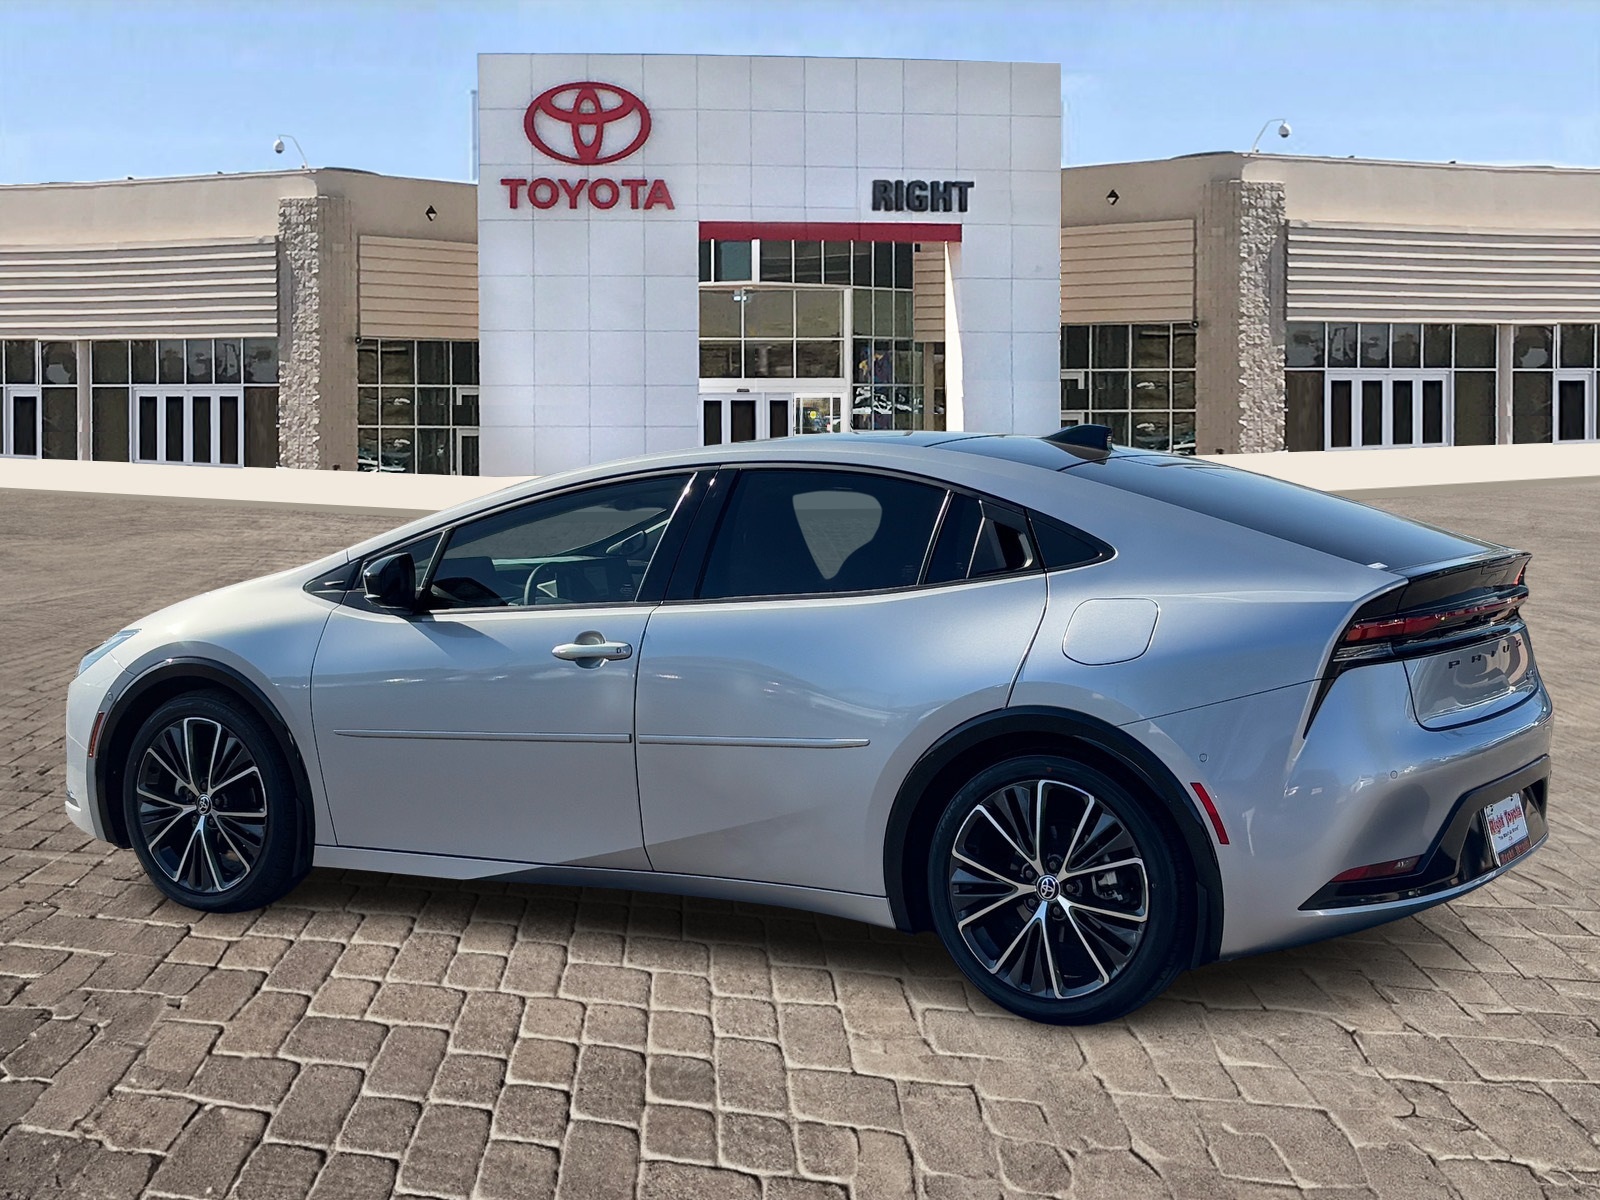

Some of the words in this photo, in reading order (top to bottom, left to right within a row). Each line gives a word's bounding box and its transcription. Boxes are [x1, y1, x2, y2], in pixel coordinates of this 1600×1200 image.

[501, 177, 675, 210] TOYOTA
[872, 179, 975, 212] RIGHT
[1448, 638, 1522, 669] PRIUS
